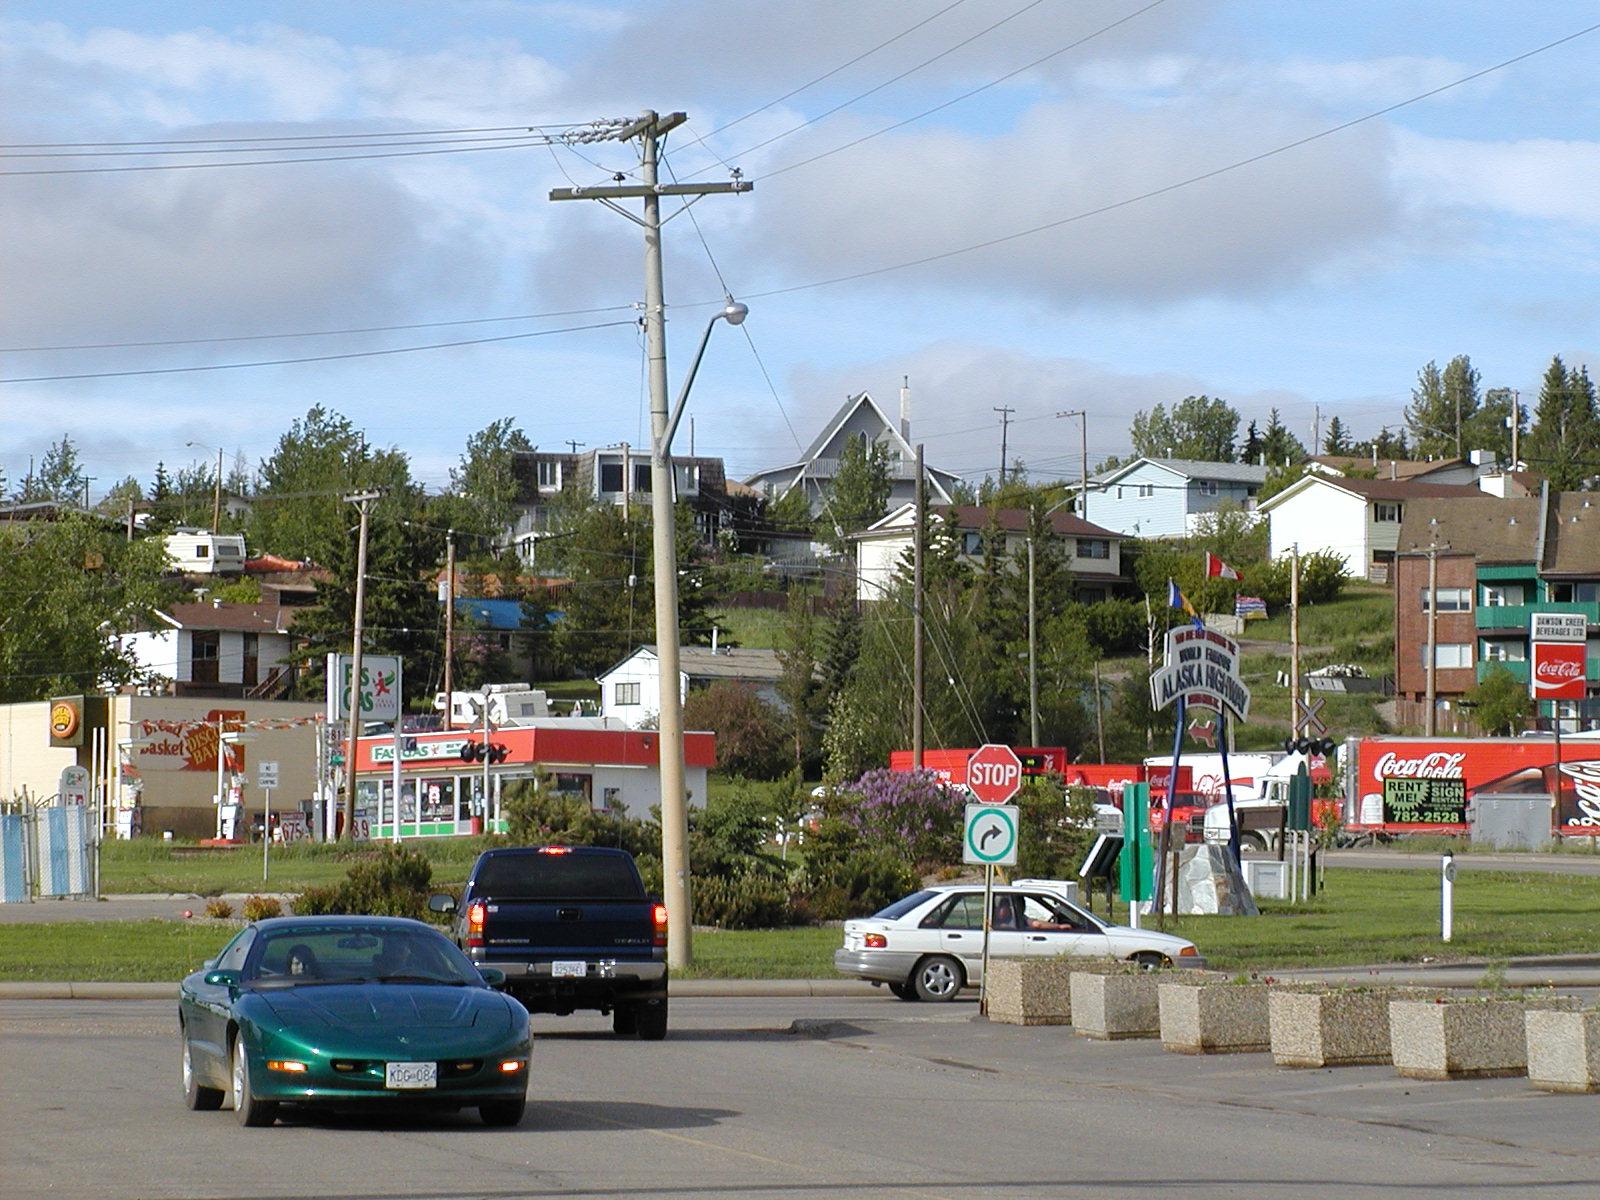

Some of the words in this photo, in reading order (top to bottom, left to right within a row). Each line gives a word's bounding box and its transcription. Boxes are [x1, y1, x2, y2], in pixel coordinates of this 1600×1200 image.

[1537, 616, 1562, 626] DAWSON
[1566, 617, 1585, 627] CREEK
[1536, 627, 1571, 636] BEVERAGES
[1162, 663, 1203, 703] ALASKA
[1205, 663, 1248, 715] HIGHWAY
[971, 762, 1018, 787] STOP
[1388, 781, 1424, 792] RENT
[1394, 792, 1418, 803] ME!
[1431, 787, 1465, 798] SIGN
[1392, 811, 1460, 823] 782-2528
